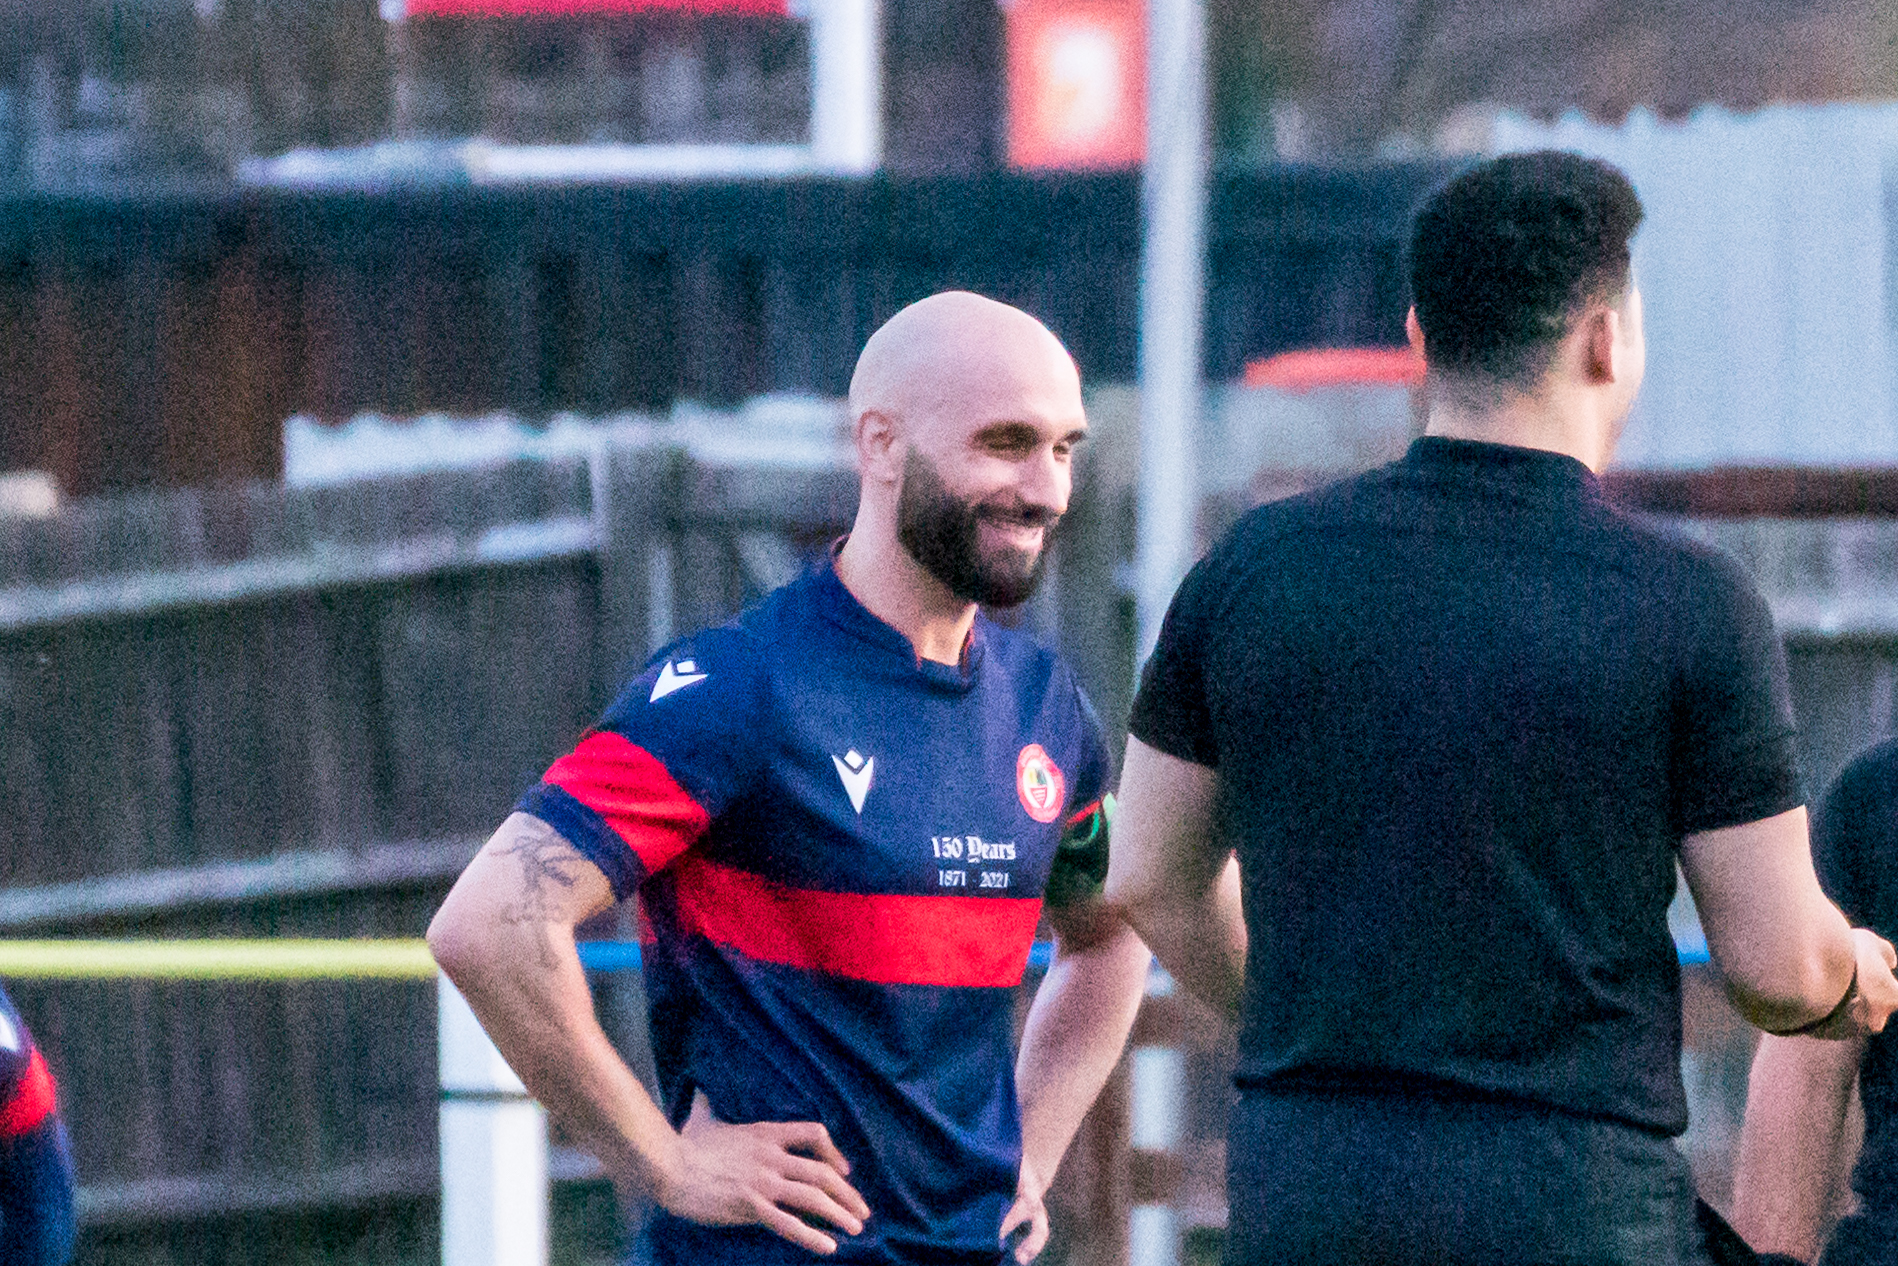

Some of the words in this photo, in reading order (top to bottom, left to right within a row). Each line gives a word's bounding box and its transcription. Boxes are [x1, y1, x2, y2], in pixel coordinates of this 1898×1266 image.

[931, 836, 964, 858] 150
[939, 869, 966, 887] 1871
[979, 870, 1010, 888] 2021
